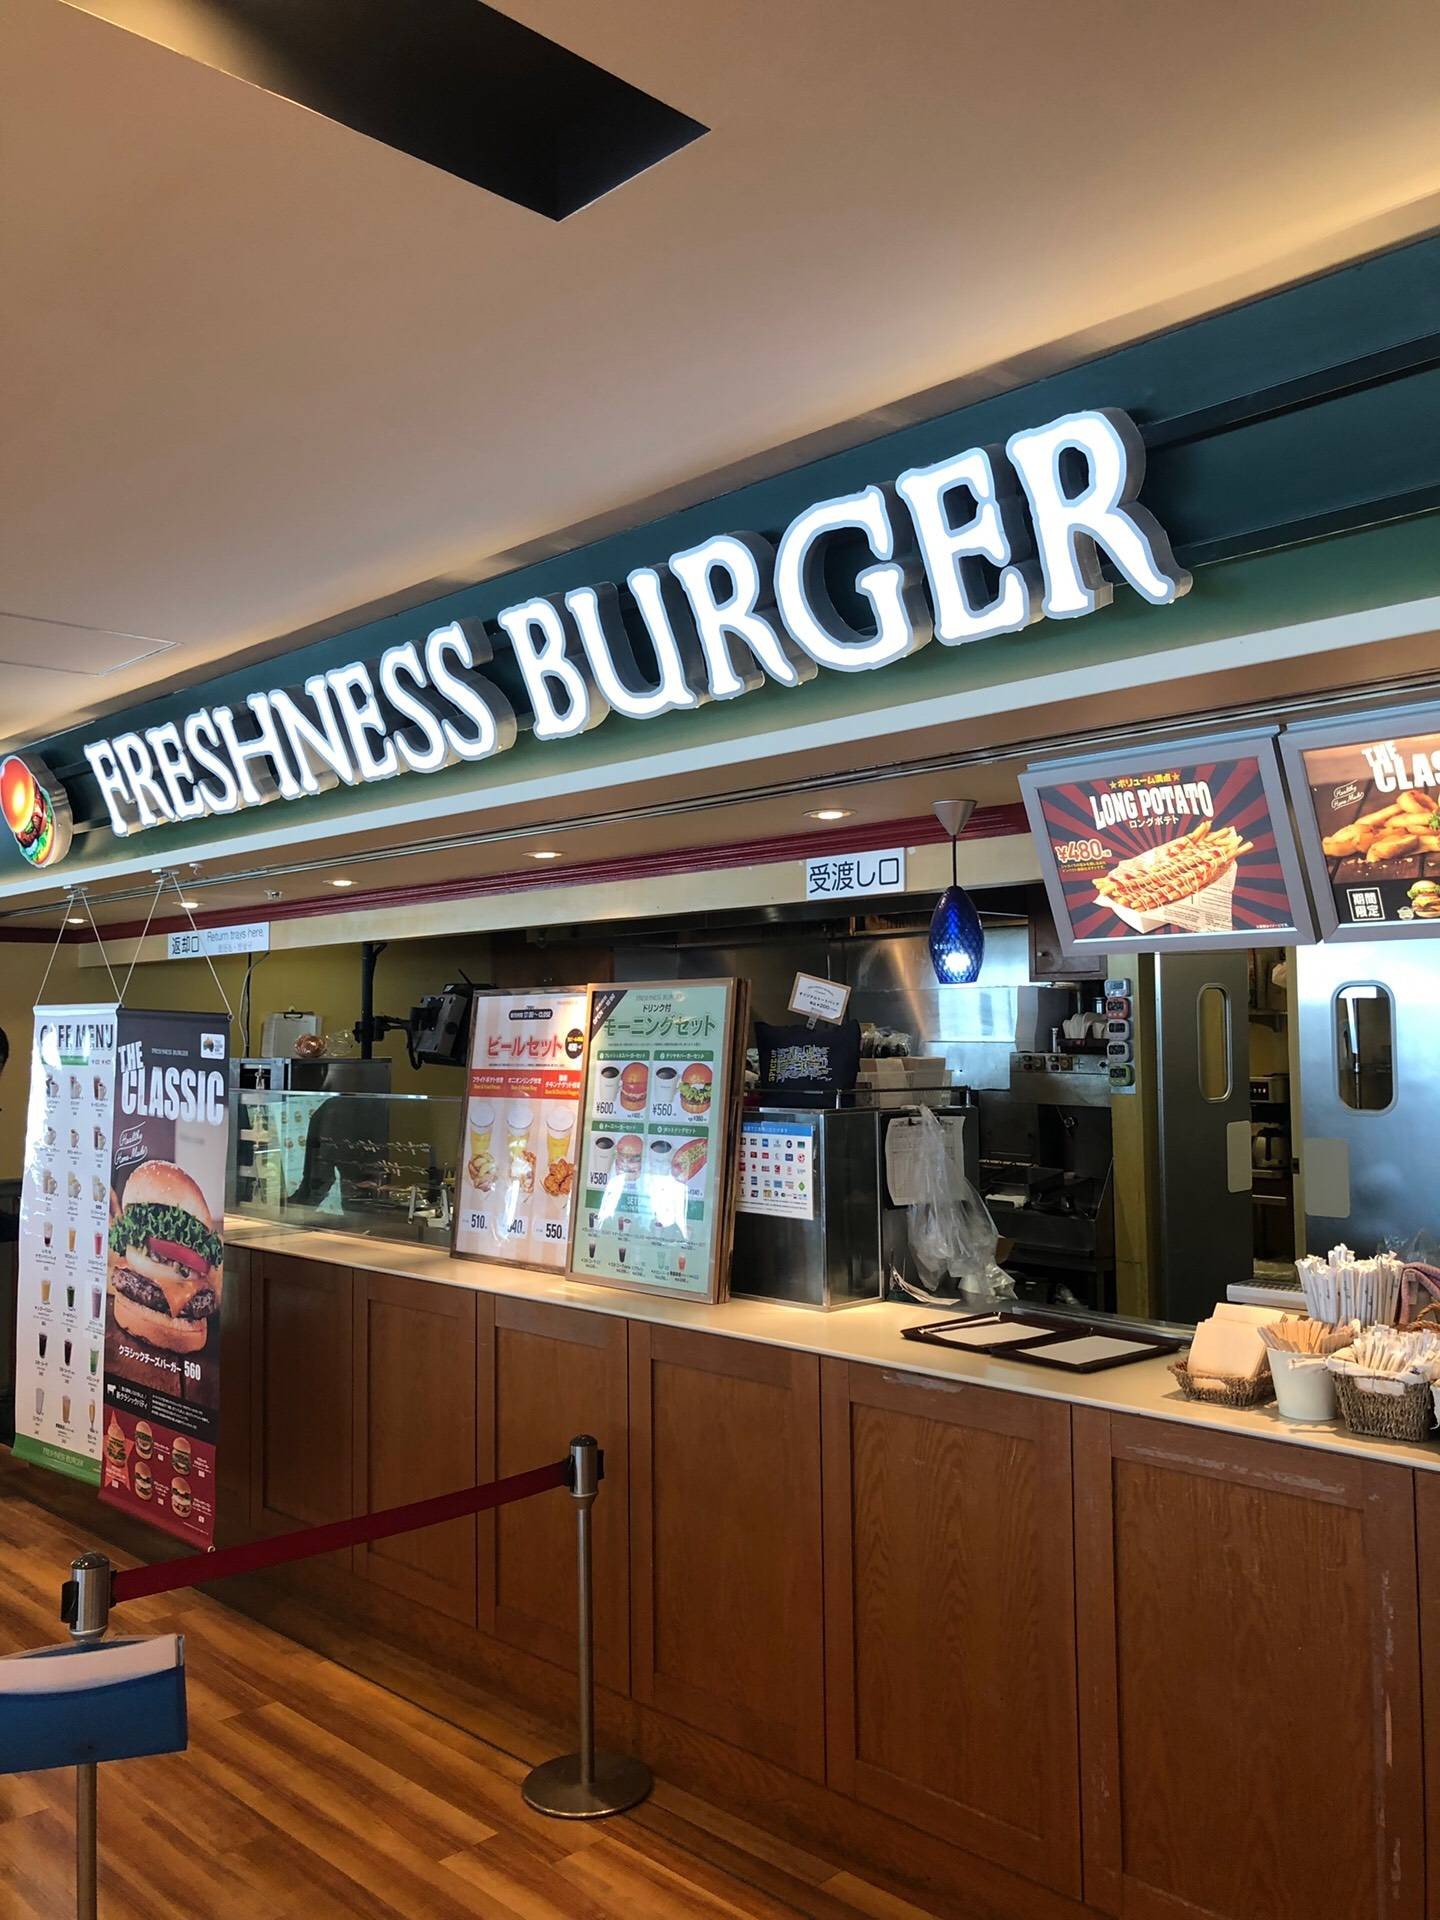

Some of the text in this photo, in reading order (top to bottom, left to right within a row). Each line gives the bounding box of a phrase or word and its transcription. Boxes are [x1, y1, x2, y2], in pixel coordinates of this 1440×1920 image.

[84, 407, 1176, 838] FRESHNESS BURGER
[1361, 741, 1397, 769] THE
[1089, 781, 1214, 831] LONG POTATO
[1129, 816, 1179, 829] ロングポテト
[1055, 839, 1102, 863] ¥480
[809, 857, 899, 894] 受渡し口
[1352, 891, 1377, 907] 期間
[1354, 904, 1380, 919] 限定
[172, 936, 199, 955] 返却口
[603, 1014, 716, 1037] モーニングセット
[118, 1040, 144, 1073] THE
[487, 1034, 562, 1058] ビールセット
[121, 1065, 225, 1126] CLASSIC
[652, 1103, 673, 1116] ¥560
[471, 1214, 486, 1228] 510
[545, 1223, 562, 1239] 550
[118, 1344, 201, 1381] クラシックチーズバーガー 560
